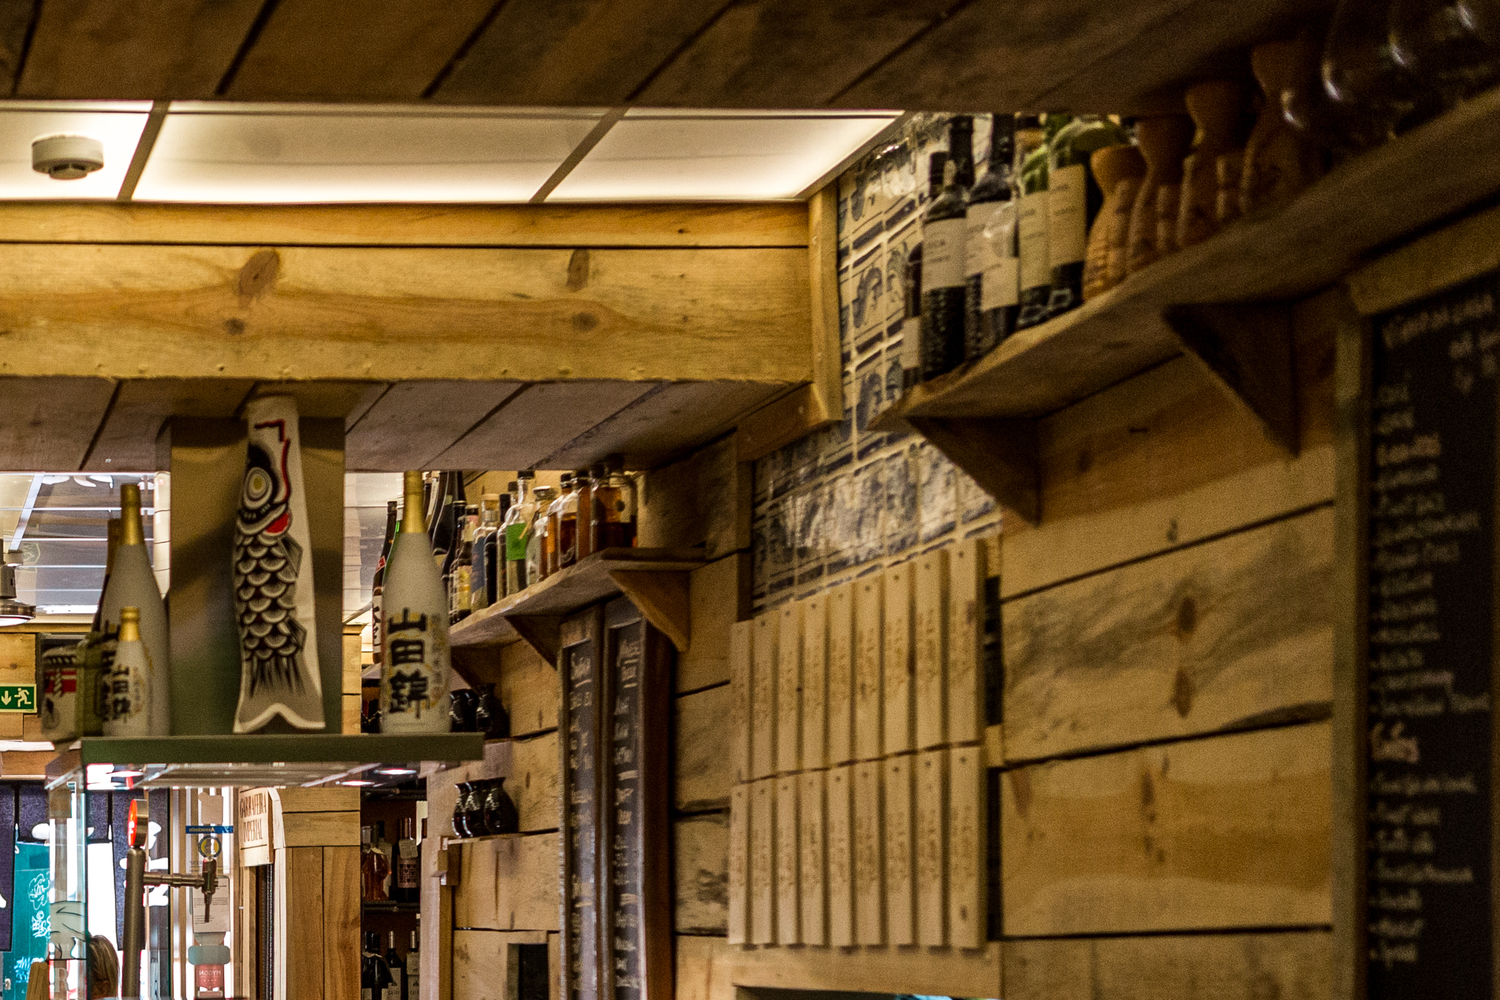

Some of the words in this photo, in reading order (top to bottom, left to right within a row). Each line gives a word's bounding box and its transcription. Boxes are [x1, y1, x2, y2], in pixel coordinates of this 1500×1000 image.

[388, 607, 429, 719] 山田錦
[240, 792, 267, 818] GARRAFEIRA
[243, 818, 263, 842] IMPERIAL
